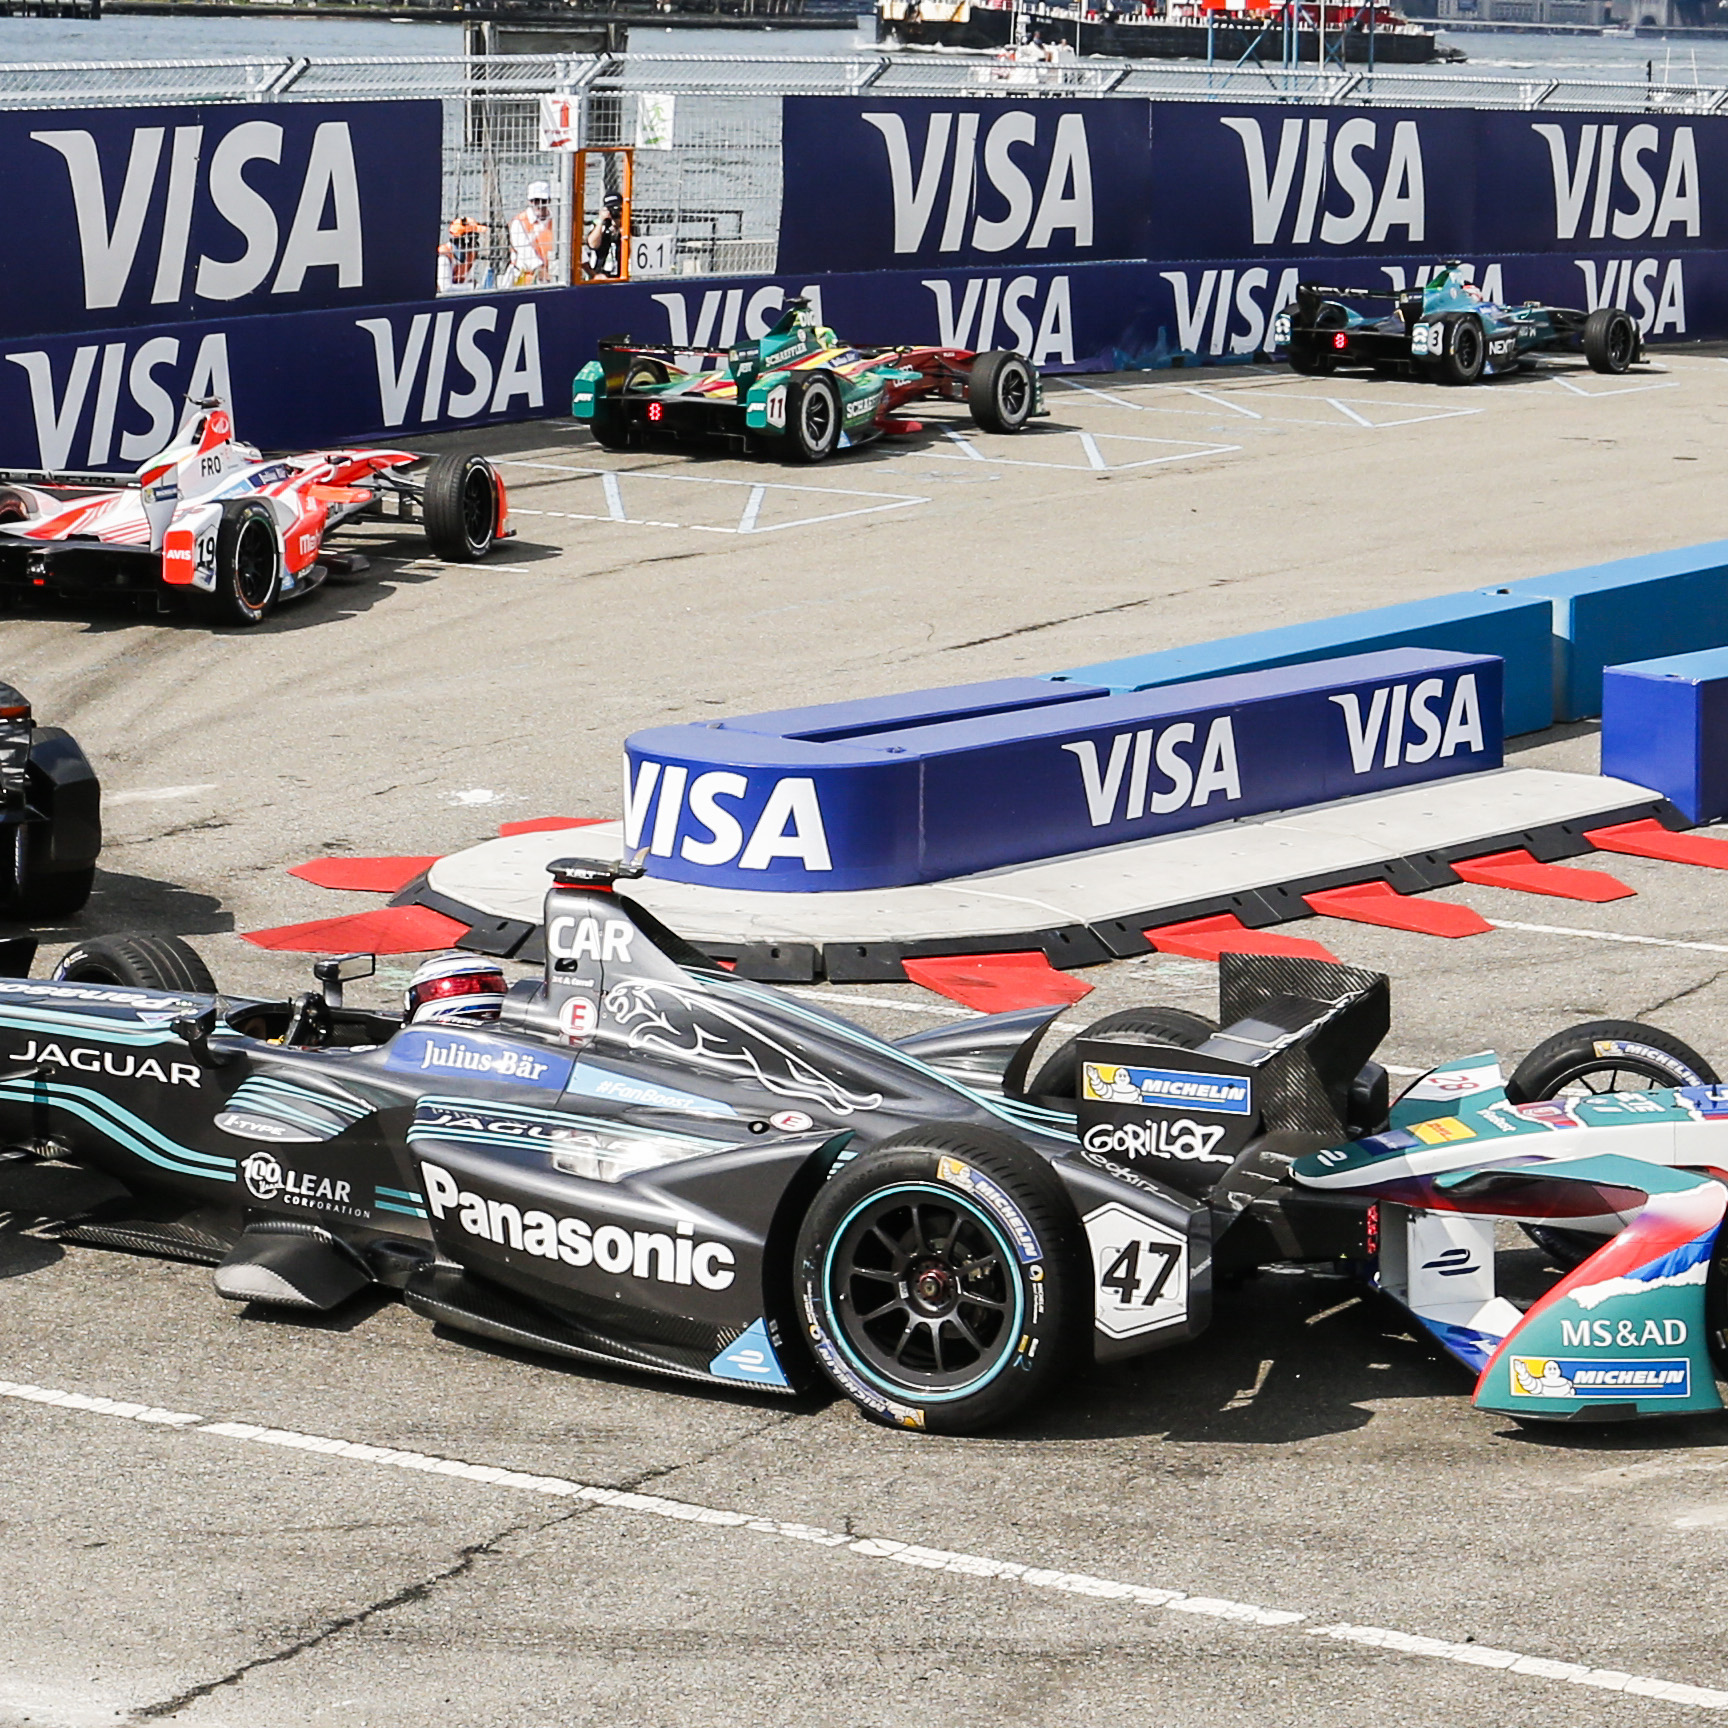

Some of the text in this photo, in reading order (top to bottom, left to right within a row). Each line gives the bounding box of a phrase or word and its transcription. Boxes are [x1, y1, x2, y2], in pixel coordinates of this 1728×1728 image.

[861, 110, 1094, 254] VISA
[1220, 117, 1425, 245] VISA
[1532, 123, 1701, 240] VISA
[31, 120, 363, 310] VISA
[636, 243, 665, 269] 6.1
[922, 274, 1076, 366] VISA
[1160, 267, 1300, 356] VISA
[1574, 258, 1686, 334] VISA
[765, 342, 807, 367] SCHAEFFLER
[1431, 327, 1440, 348] 3
[356, 303, 544, 427] VISA
[6, 333, 238, 470] VISA
[770, 397, 784, 419] 11
[201, 456, 222, 477] FRO
[166, 549, 191, 561] AVIS
[197, 536, 215, 568] 19
[1328, 673, 1484, 775] VISA
[1062, 715, 1241, 827] VISA
[623, 751, 831, 872] VISA
[549, 915, 634, 963] CAR
[9, 1040, 202, 1089] JAGUAR
[421, 1040, 549, 1082] Julius Bär
[1625, 1043, 1701, 1087] MICHELIN
[595, 1080, 694, 1110] #FanBoost
[1141, 1078, 1247, 1101] MICHELIN
[225, 1114, 285, 1136] I-TYPE
[283, 1194, 371, 1218] CORPORATION
[285, 1170, 352, 1203] LEAR
[421, 1161, 736, 1291] Panasonic
[974, 1180, 1038, 1258] MICHELIN
[1101, 1239, 1182, 1306] 47
[1560, 1320, 1687, 1347] MS&AD
[818, 1347, 887, 1413] MICHELIN
[1572, 1369, 1685, 1384] MICHELIN
